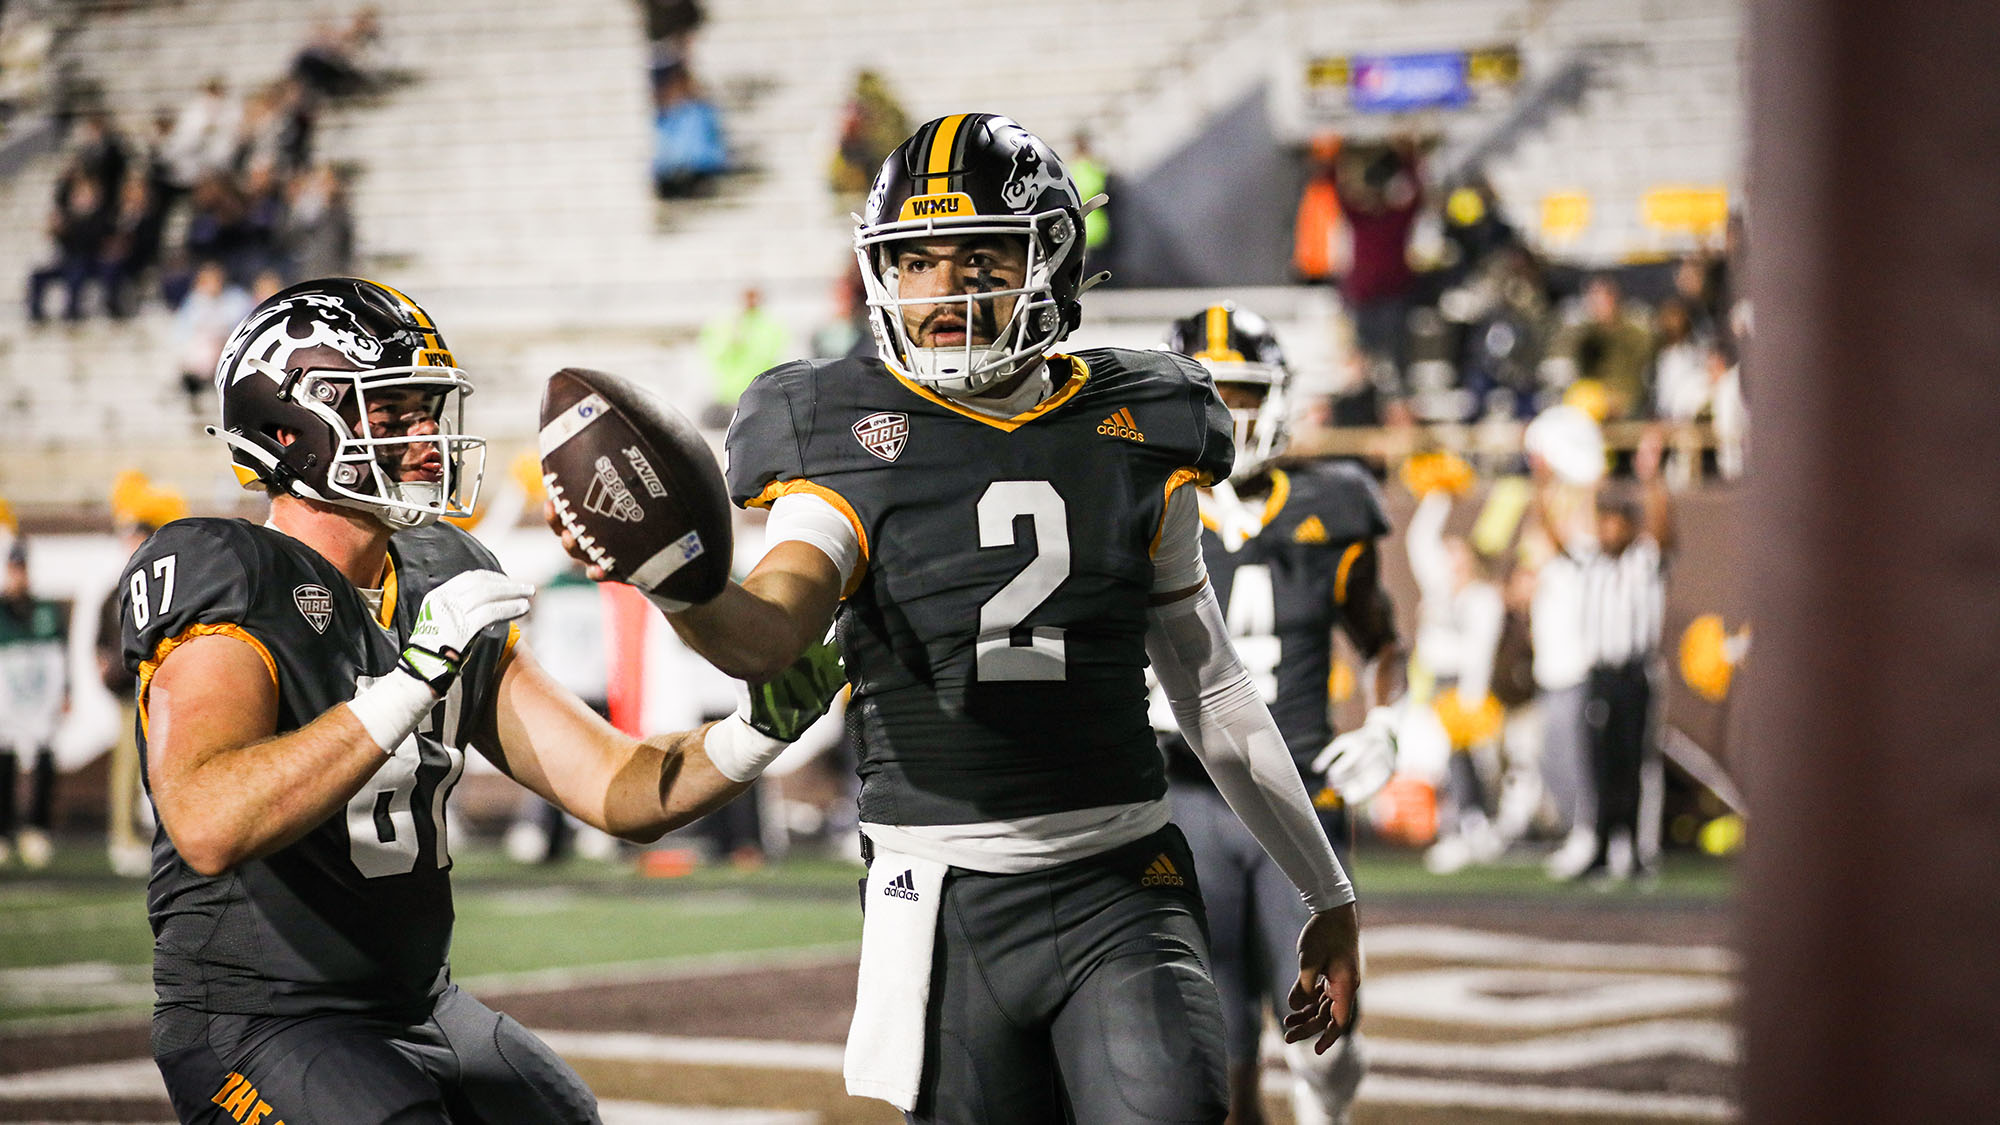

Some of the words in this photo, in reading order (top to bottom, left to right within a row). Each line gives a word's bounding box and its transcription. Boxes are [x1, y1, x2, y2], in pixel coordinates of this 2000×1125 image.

[912, 198, 960, 216] WMU
[861, 424, 908, 447] MAC
[1096, 423, 1145, 442] adidas
[621, 445, 668, 498] DIME
[595, 456, 645, 522] adidas
[976, 480, 1070, 682] 2
[129, 554, 177, 631] 87
[299, 599, 332, 612] MAC
[1141, 873, 1184, 887] adidas
[884, 886, 920, 902] adidas
